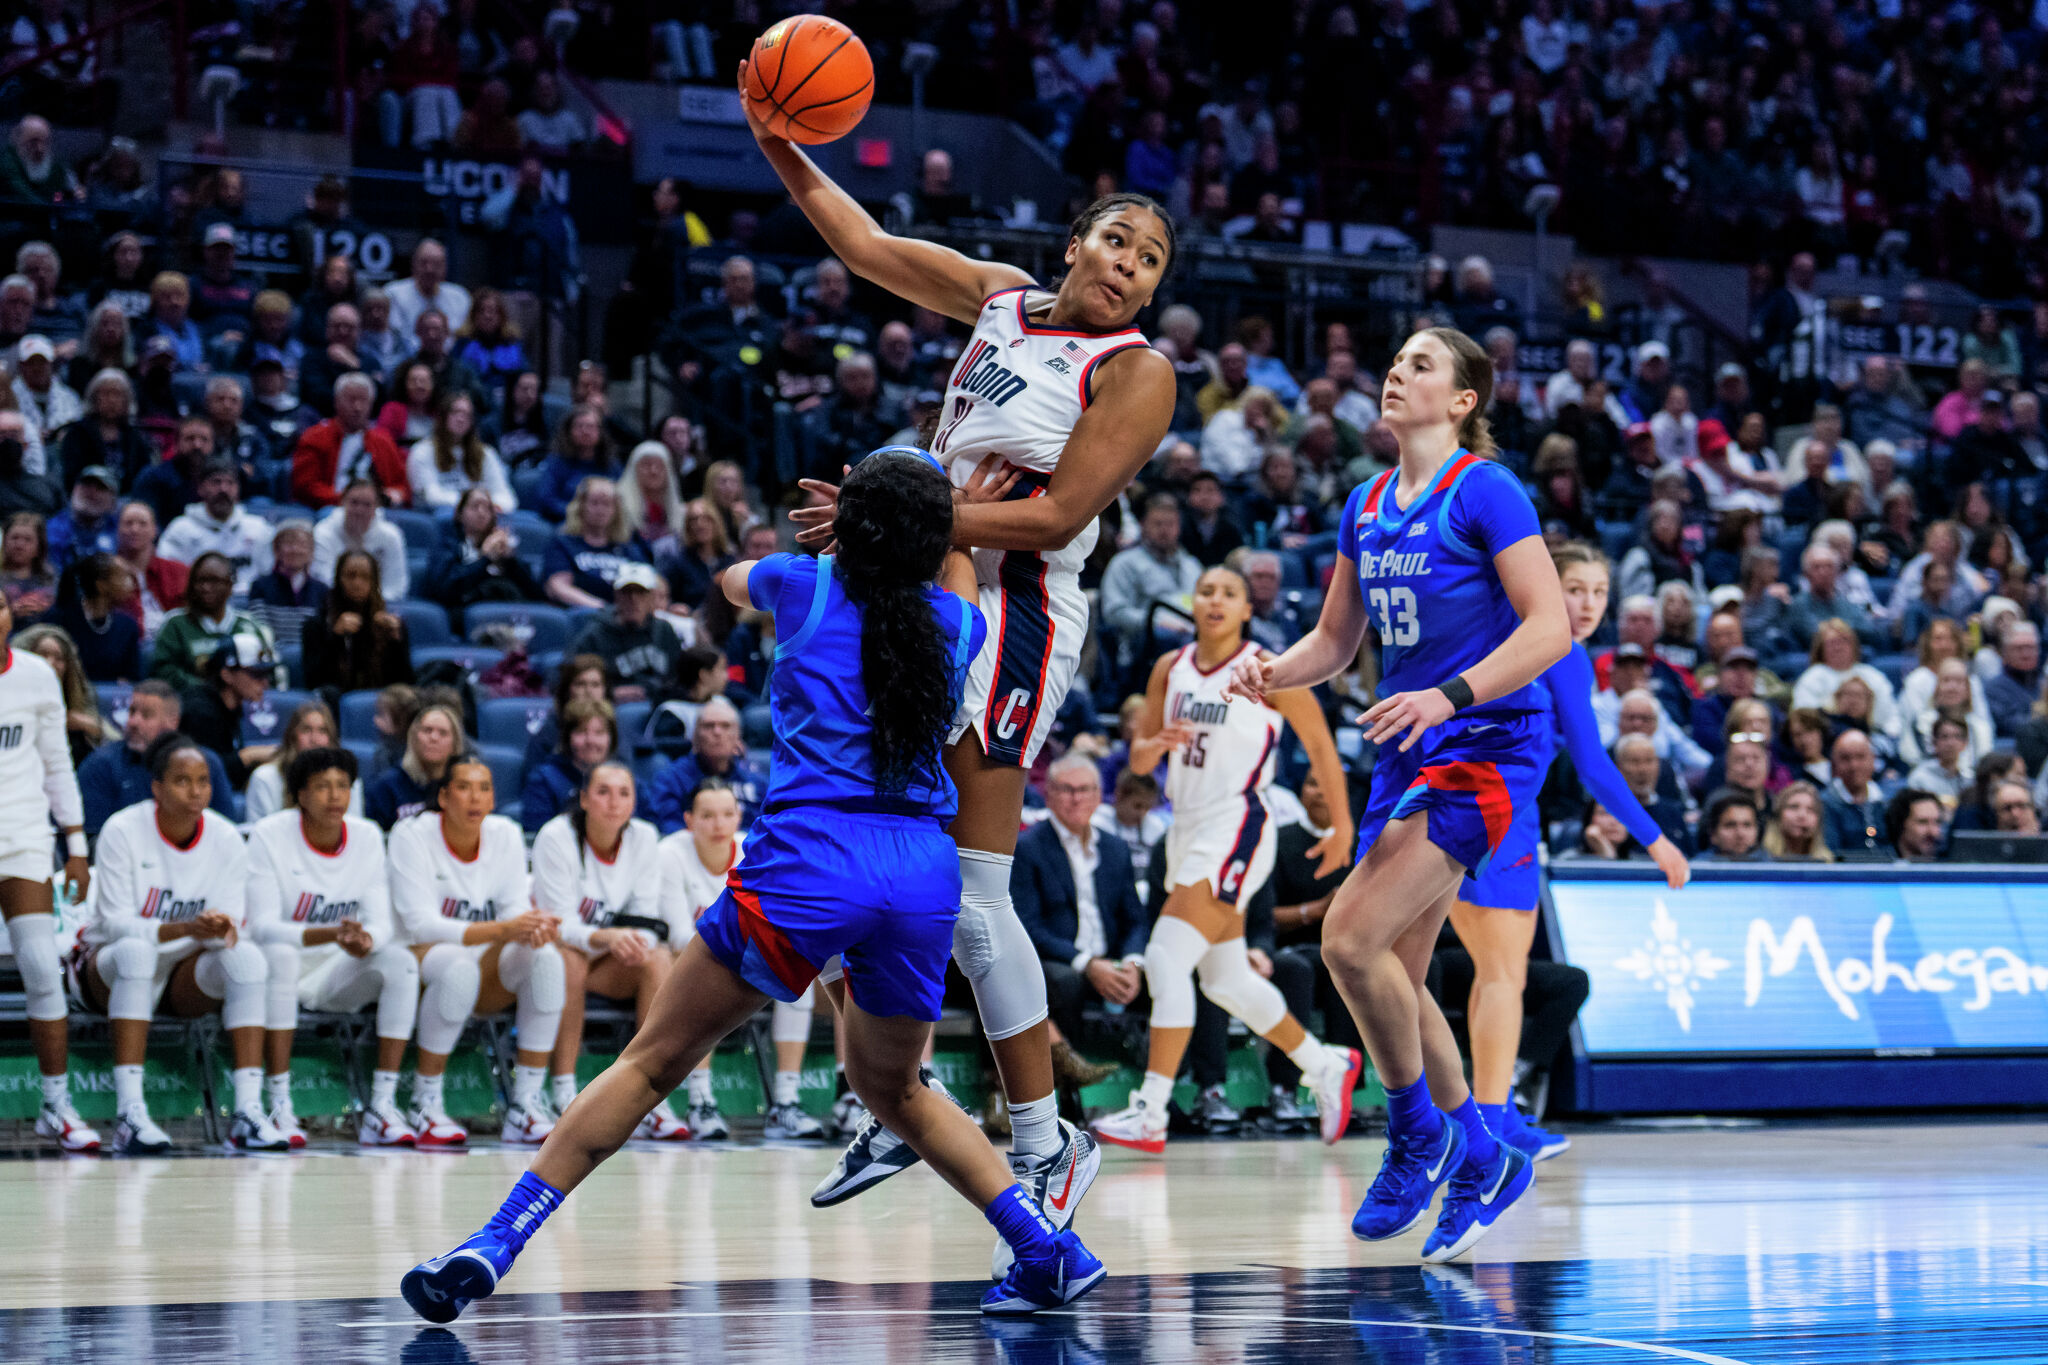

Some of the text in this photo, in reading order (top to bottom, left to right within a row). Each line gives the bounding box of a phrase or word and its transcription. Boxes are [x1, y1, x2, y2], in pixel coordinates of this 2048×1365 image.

[422, 158, 571, 203] UCON
[1895, 323, 1959, 367] 122
[953, 338, 1028, 408] UConn
[1369, 586, 1421, 646] 33
[997, 687, 1031, 740] C
